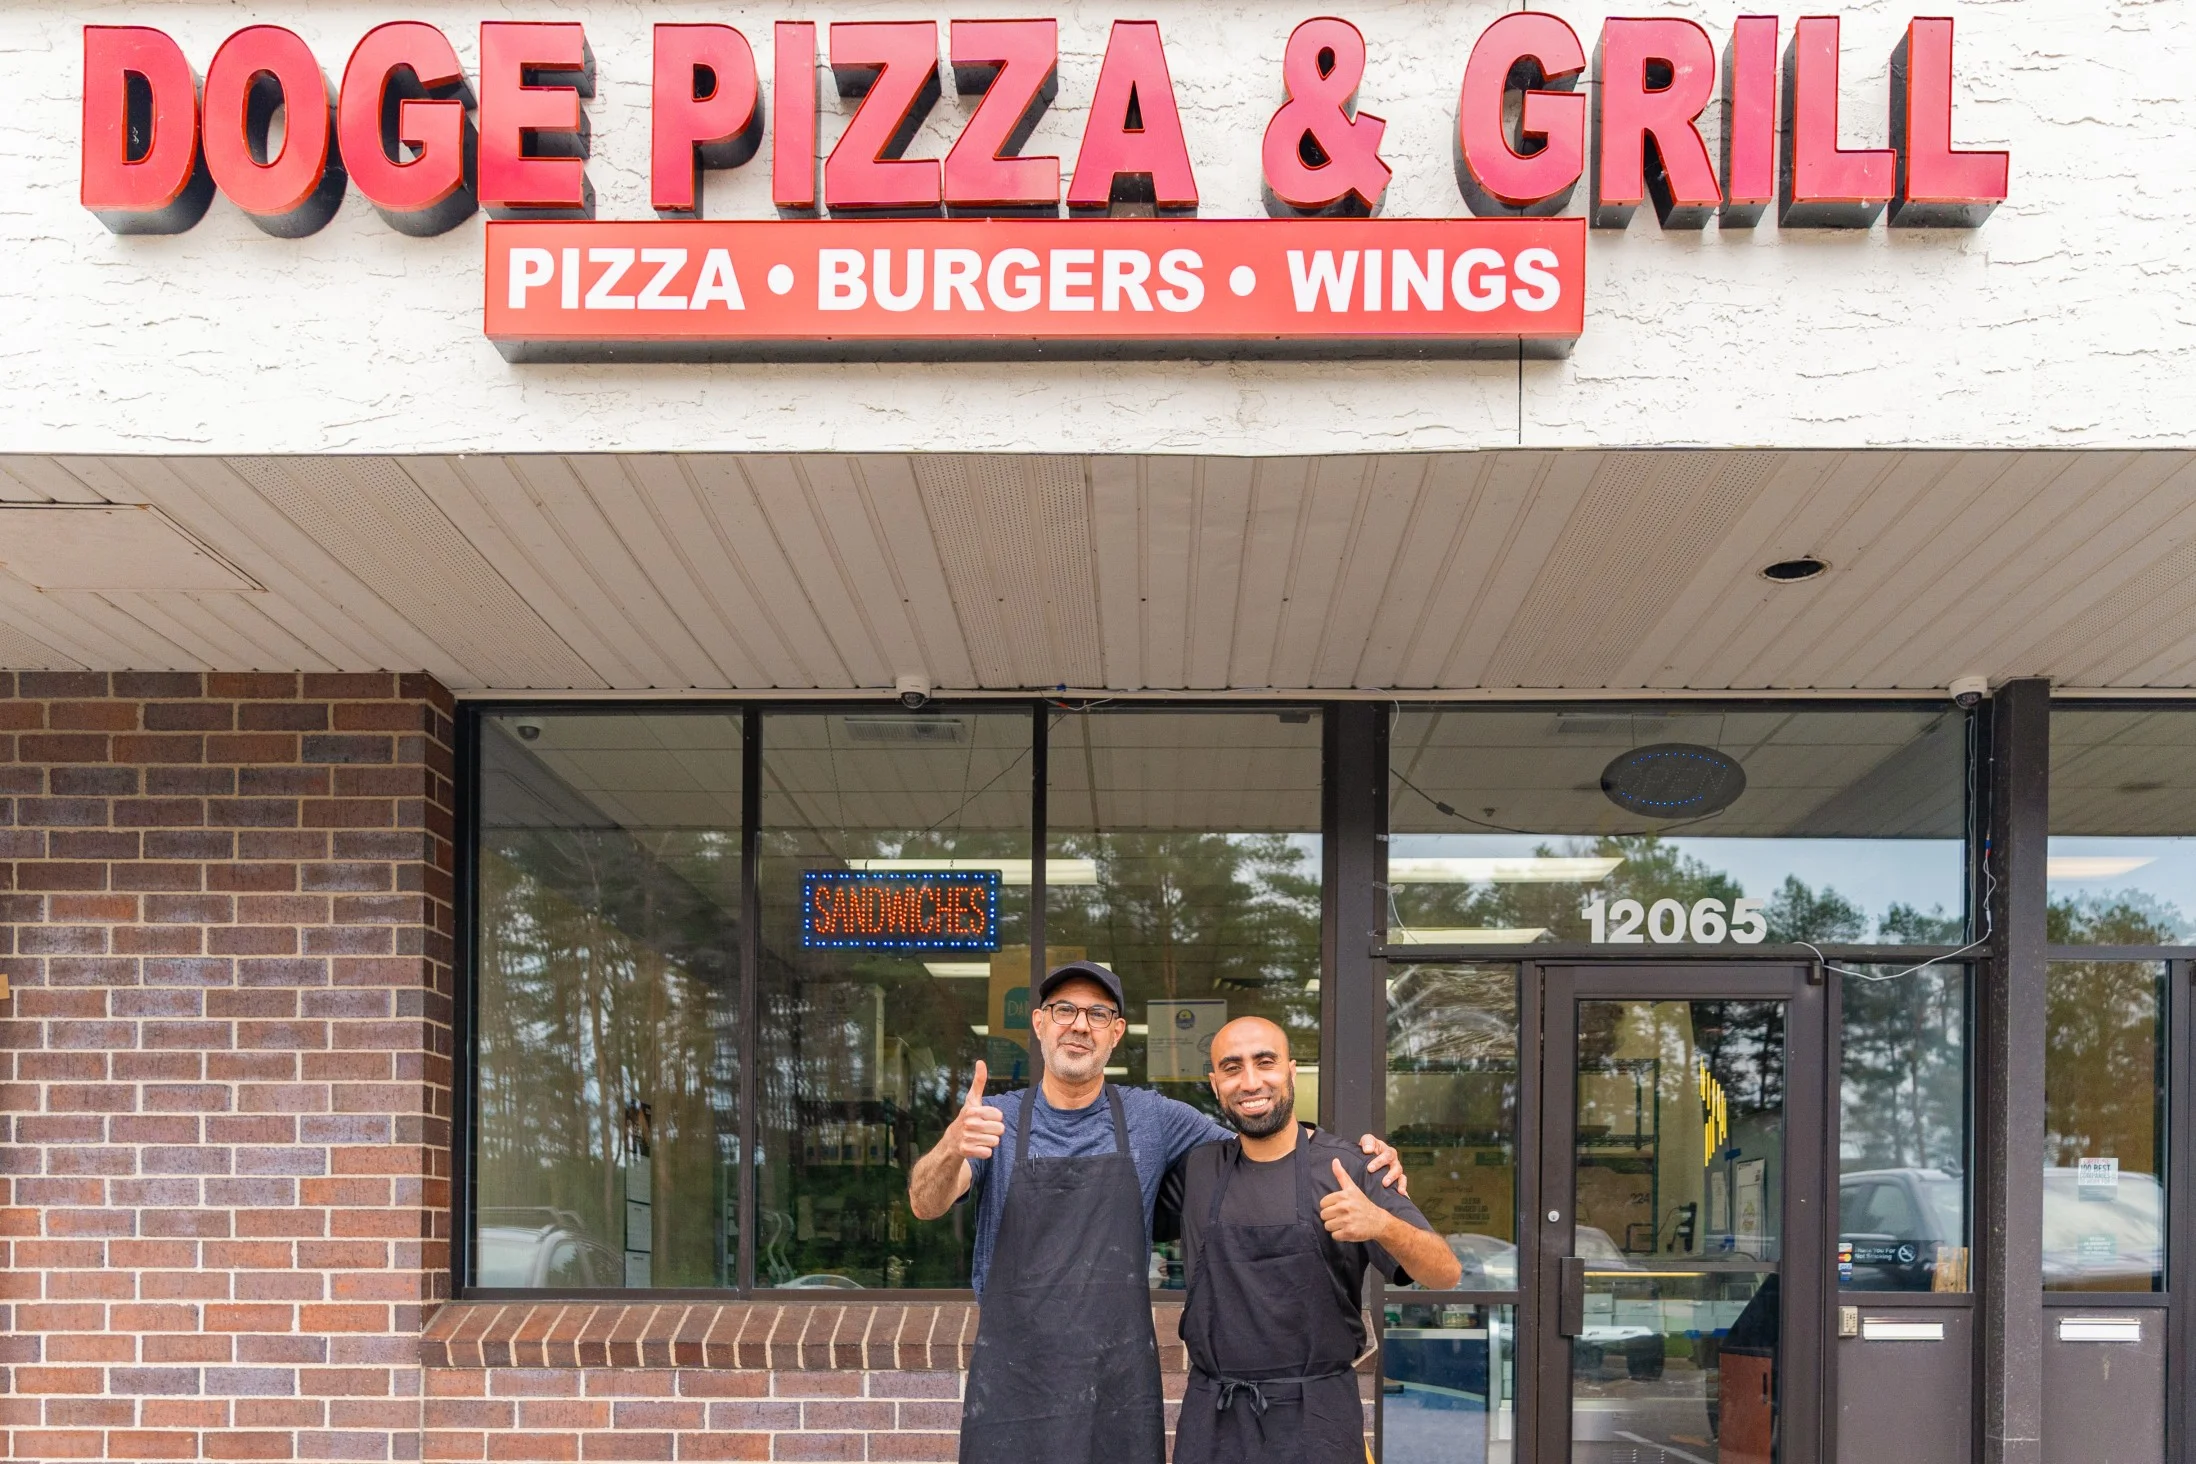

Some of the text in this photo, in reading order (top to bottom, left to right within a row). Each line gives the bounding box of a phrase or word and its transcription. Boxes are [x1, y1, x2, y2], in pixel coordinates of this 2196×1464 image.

[80, 11, 2010, 215] DOGE PIZZA & GRILL
[507, 247, 1562, 313] PIZZA BURGERS WINGS
[813, 884, 987, 936] SANDWICHES
[1581, 897, 1768, 944] 12065
[1866, 1253, 1893, 1261] Smoking
